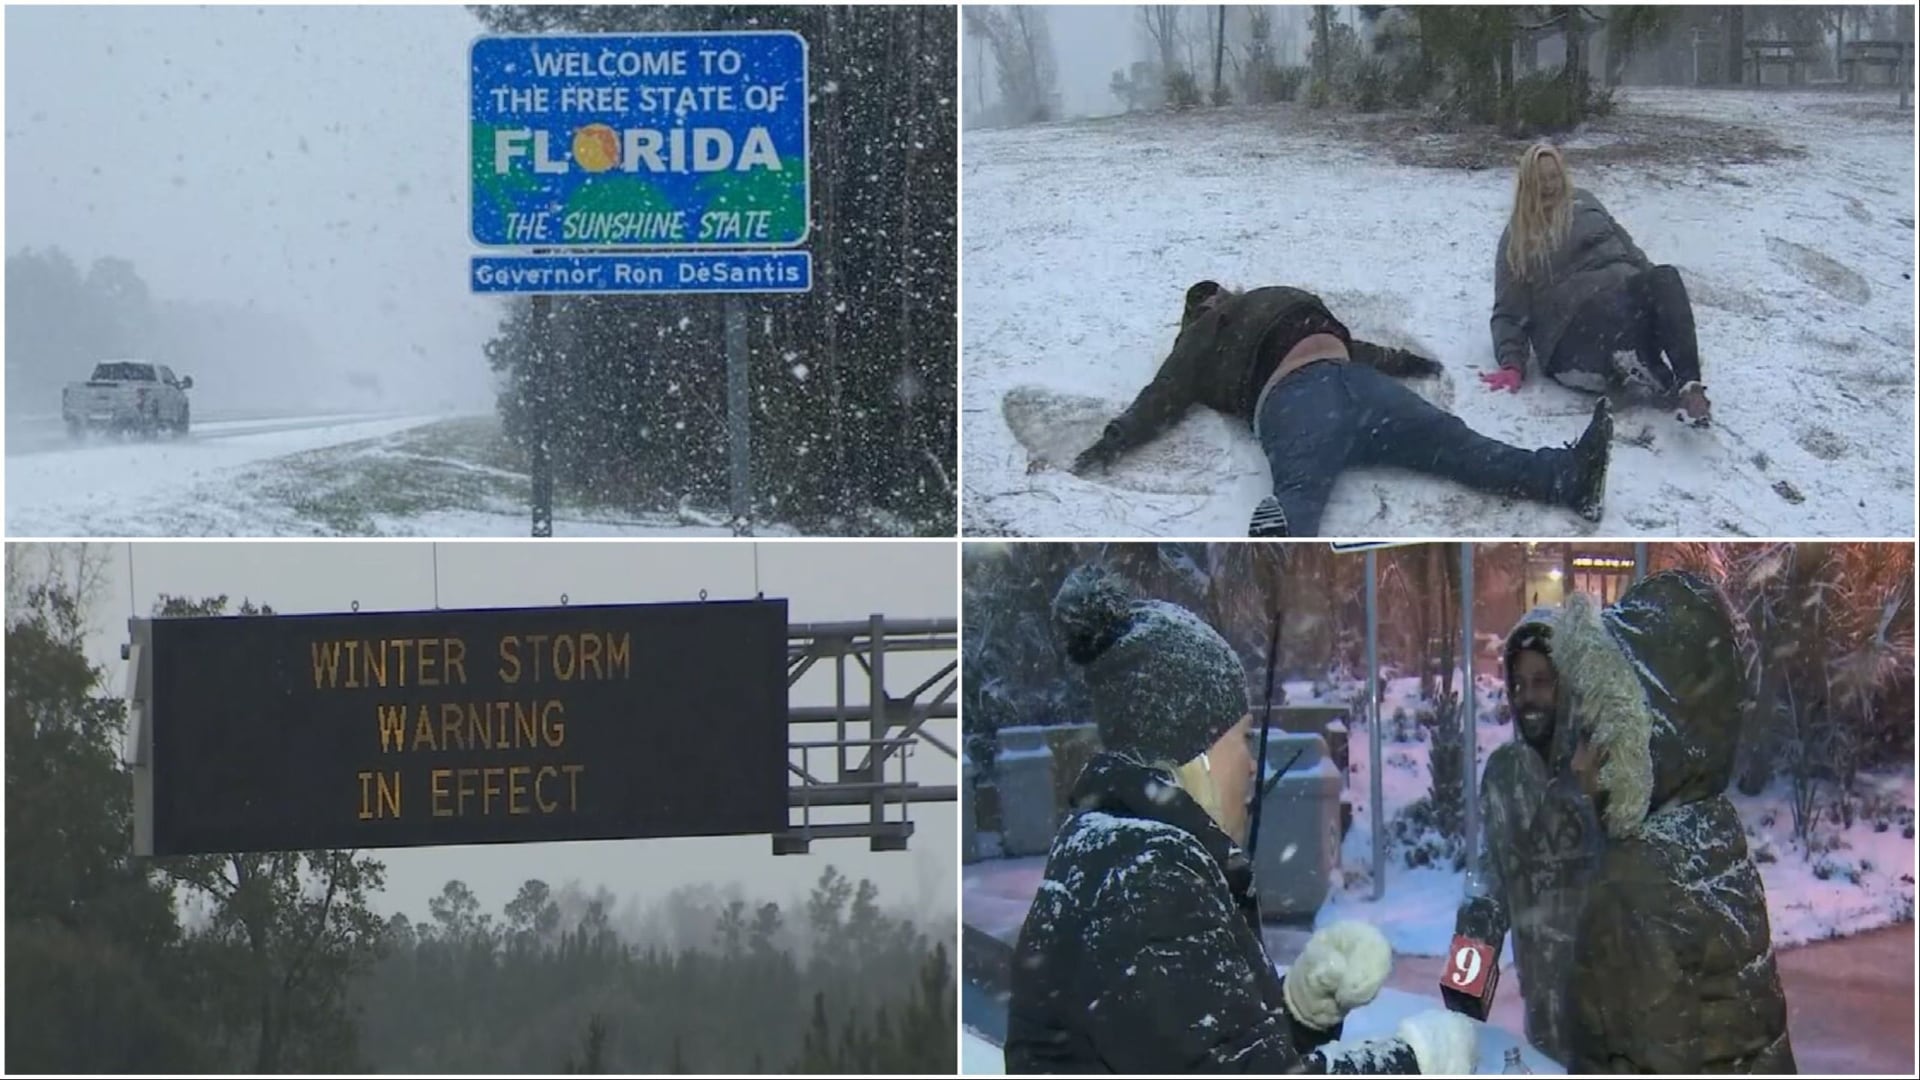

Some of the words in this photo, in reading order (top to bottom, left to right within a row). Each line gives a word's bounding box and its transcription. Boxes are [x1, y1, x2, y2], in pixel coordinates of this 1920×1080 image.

[533, 51, 687, 77] WELCOME
[701, 49, 741, 75] TO
[491, 87, 549, 113] THE
[561, 87, 630, 112] FREE
[638, 86, 735, 112] STATE
[745, 85, 786, 112] OF
[494, 123, 783, 174] FLORIDA
[506, 211, 549, 240] THE
[563, 211, 686, 240] SUNSHINE
[700, 210, 772, 239] STATE
[476, 265, 598, 285] Governor
[614, 264, 663, 284] Ron
[679, 262, 800, 283] DeSantis
[312, 637, 468, 689] WINTER
[499, 632, 631, 684] STORM
[378, 700, 566, 753] WARNING
[358, 771, 401, 820] IN
[431, 765, 584, 817] EFFECT
[1452, 947, 1482, 986] 9
